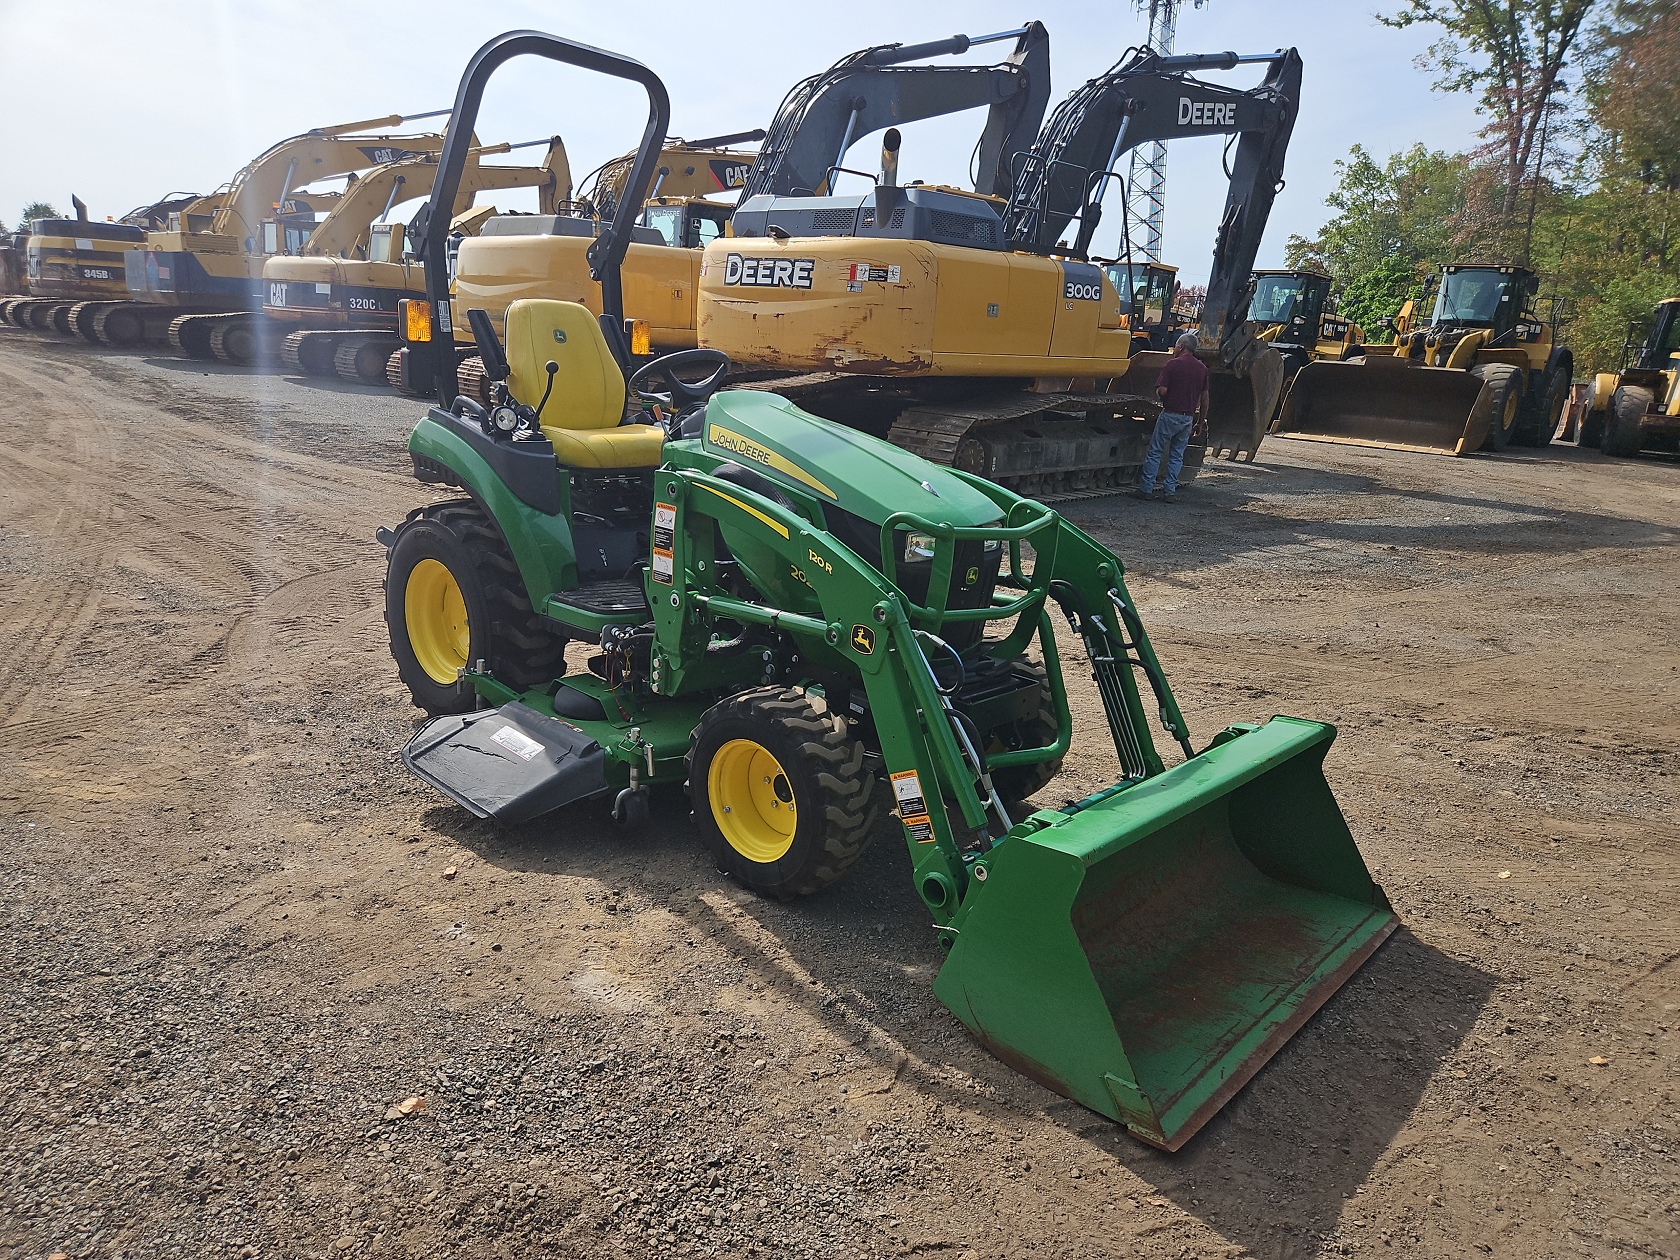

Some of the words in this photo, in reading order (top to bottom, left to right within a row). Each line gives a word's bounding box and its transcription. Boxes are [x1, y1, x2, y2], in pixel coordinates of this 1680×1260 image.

[1177, 97, 1237, 125] DEERE
[374, 148, 393, 163] CAT
[725, 165, 748, 187] CAT
[281, 200, 297, 214] AT
[84, 269, 108, 279] 345B
[724, 253, 815, 289] DEERE
[270, 283, 288, 307] CAT
[1066, 282, 1100, 300] 300G
[349, 298, 376, 310] 320C
[1065, 302, 1074, 311] LC
[1323, 323, 1337, 337] CAT
[713, 432, 739, 452] JOHN
[739, 441, 771, 464] DEERE
[660, 504, 676, 512] WARNING
[659, 551, 673, 559] WARNING
[808, 549, 825, 568] 120
[825, 561, 833, 575] R
[897, 771, 915, 779] WARNING
